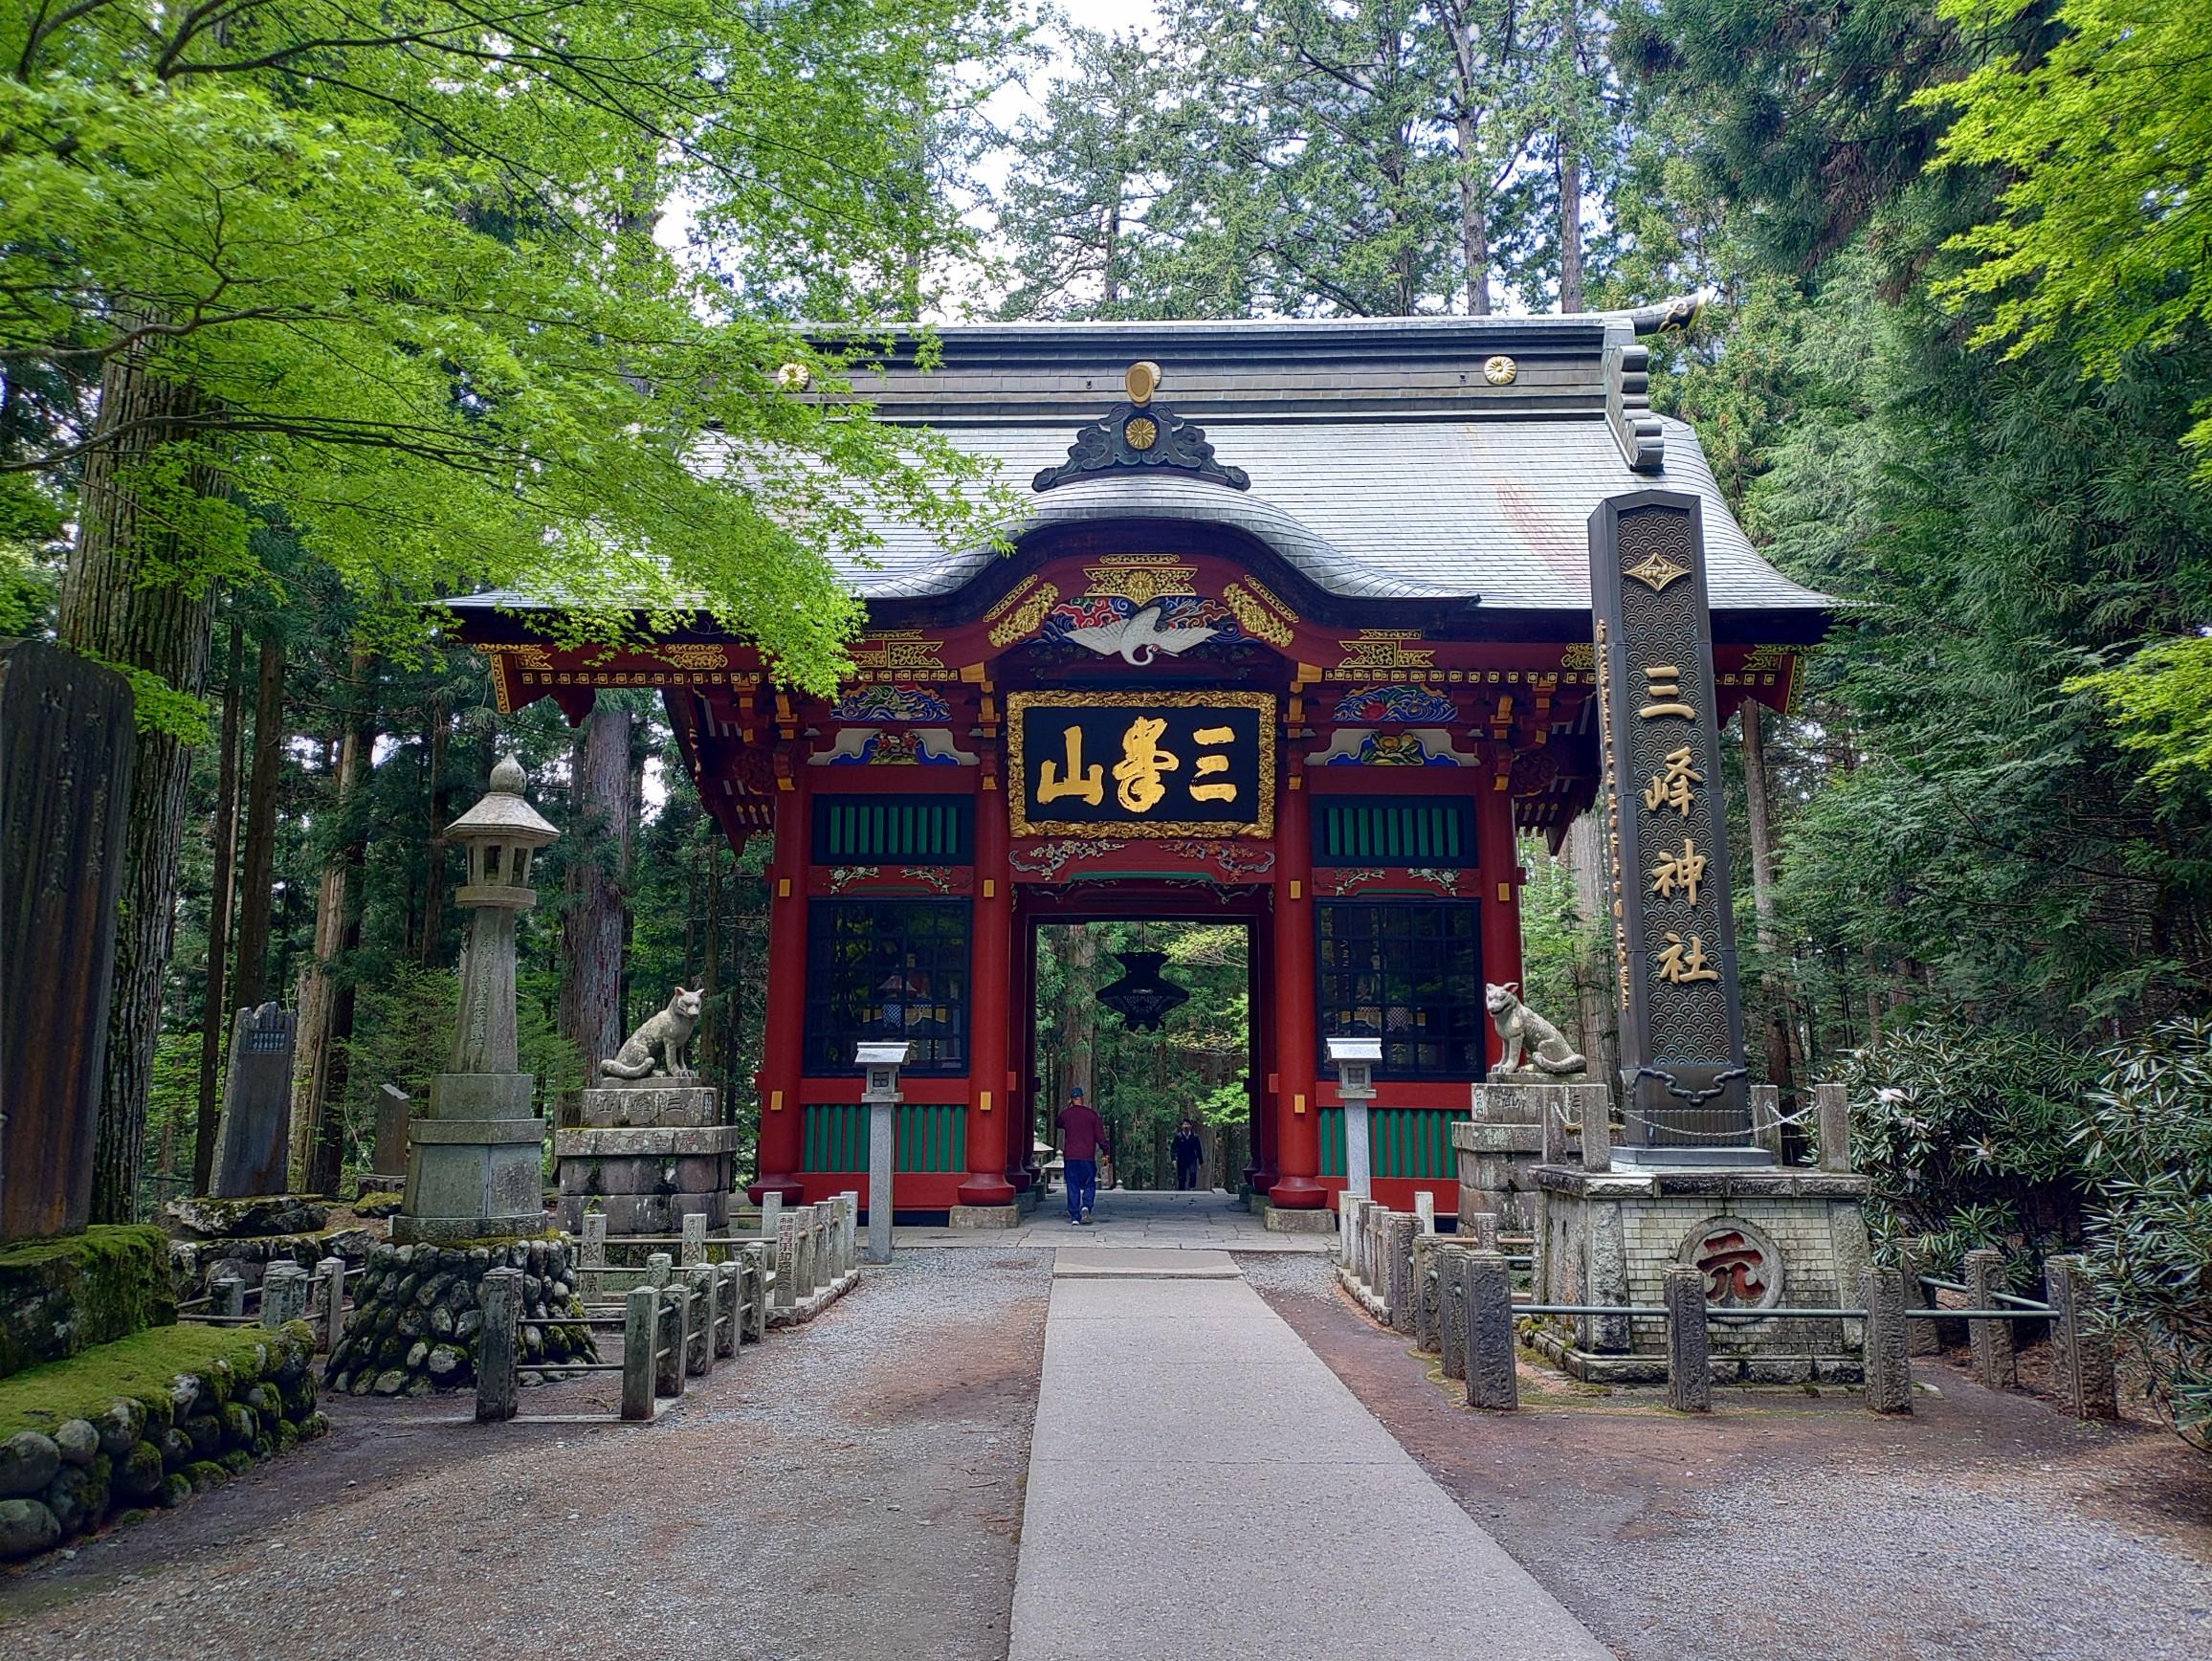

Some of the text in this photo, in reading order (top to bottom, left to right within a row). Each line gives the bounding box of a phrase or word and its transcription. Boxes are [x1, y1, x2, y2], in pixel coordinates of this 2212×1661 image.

[1638, 665, 1720, 985] 三峰神社
[1695, 1230, 1766, 1302] 元
